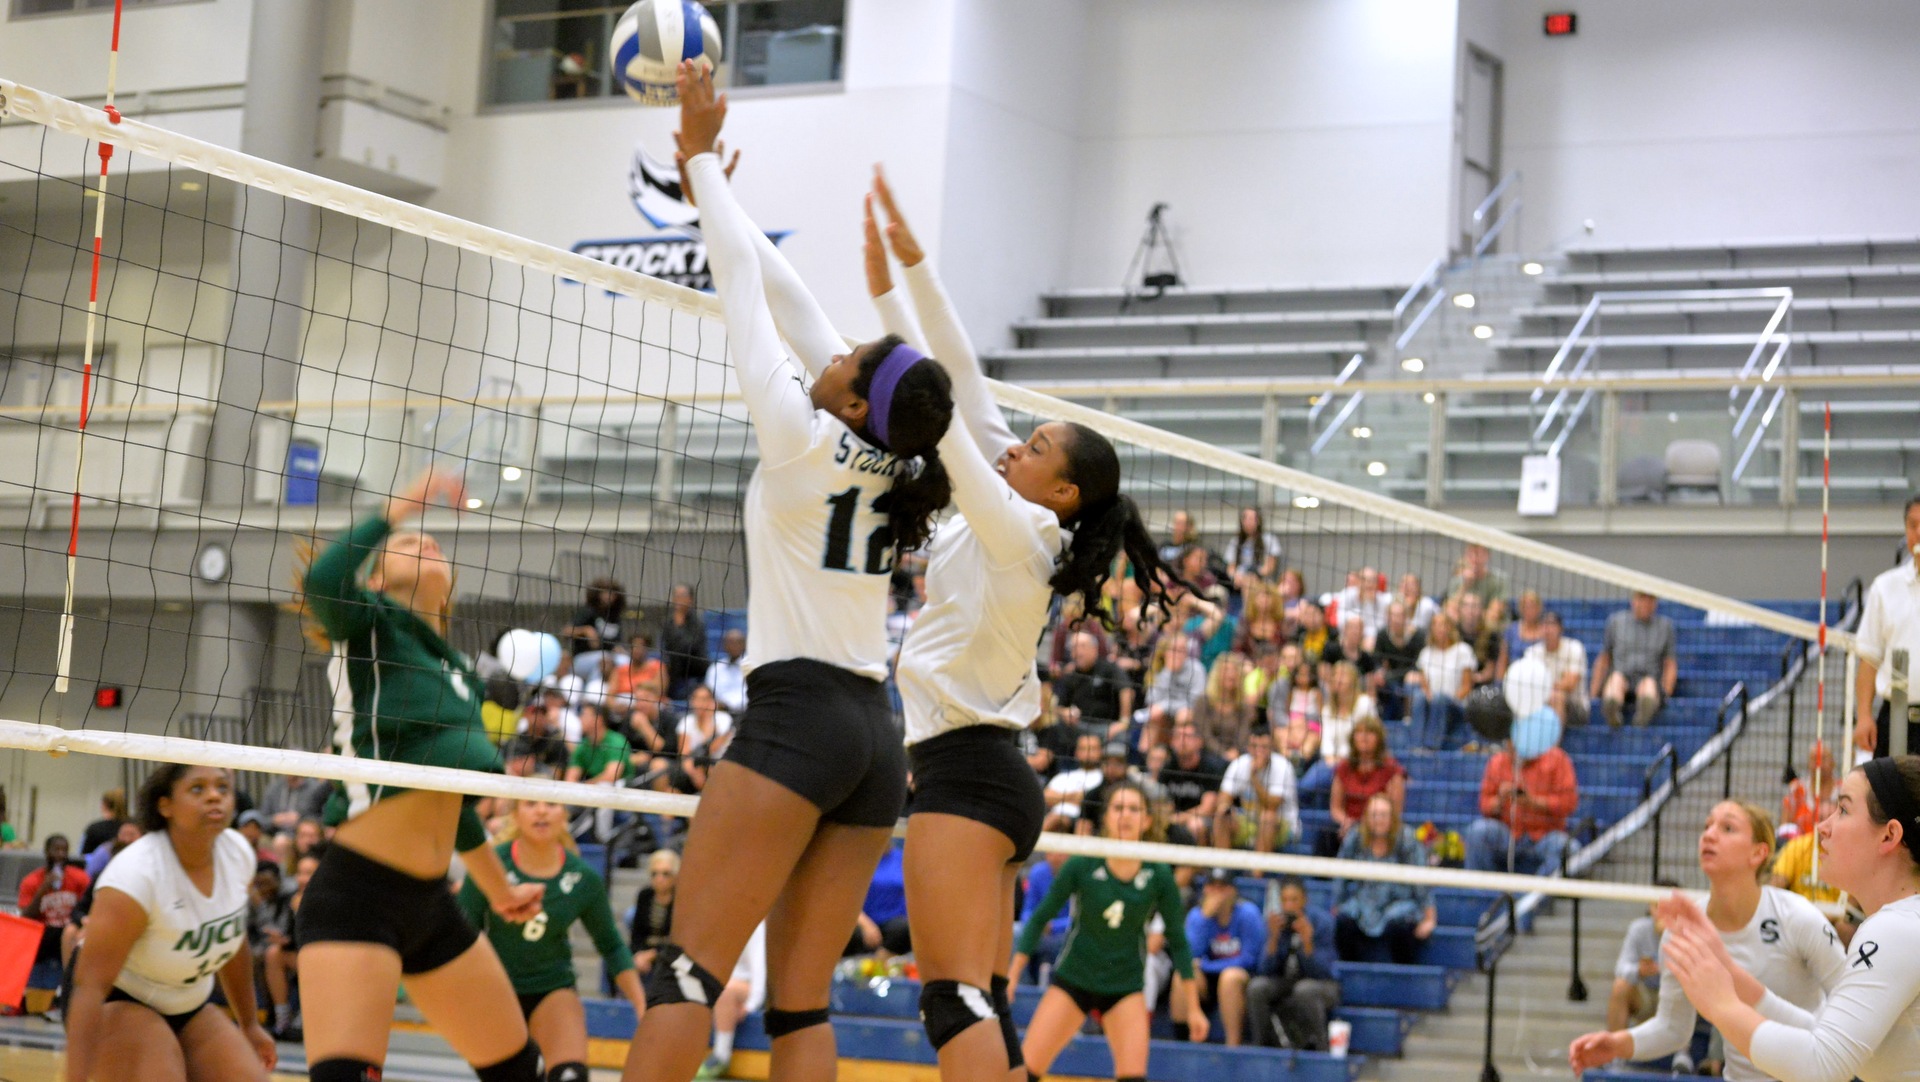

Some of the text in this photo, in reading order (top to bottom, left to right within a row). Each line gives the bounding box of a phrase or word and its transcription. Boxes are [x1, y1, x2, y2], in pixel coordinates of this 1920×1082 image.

[834, 431, 900, 476] STOCK
[522, 912, 549, 941] 6
[1103, 900, 1125, 929] 4
[1760, 919, 1780, 943] S
